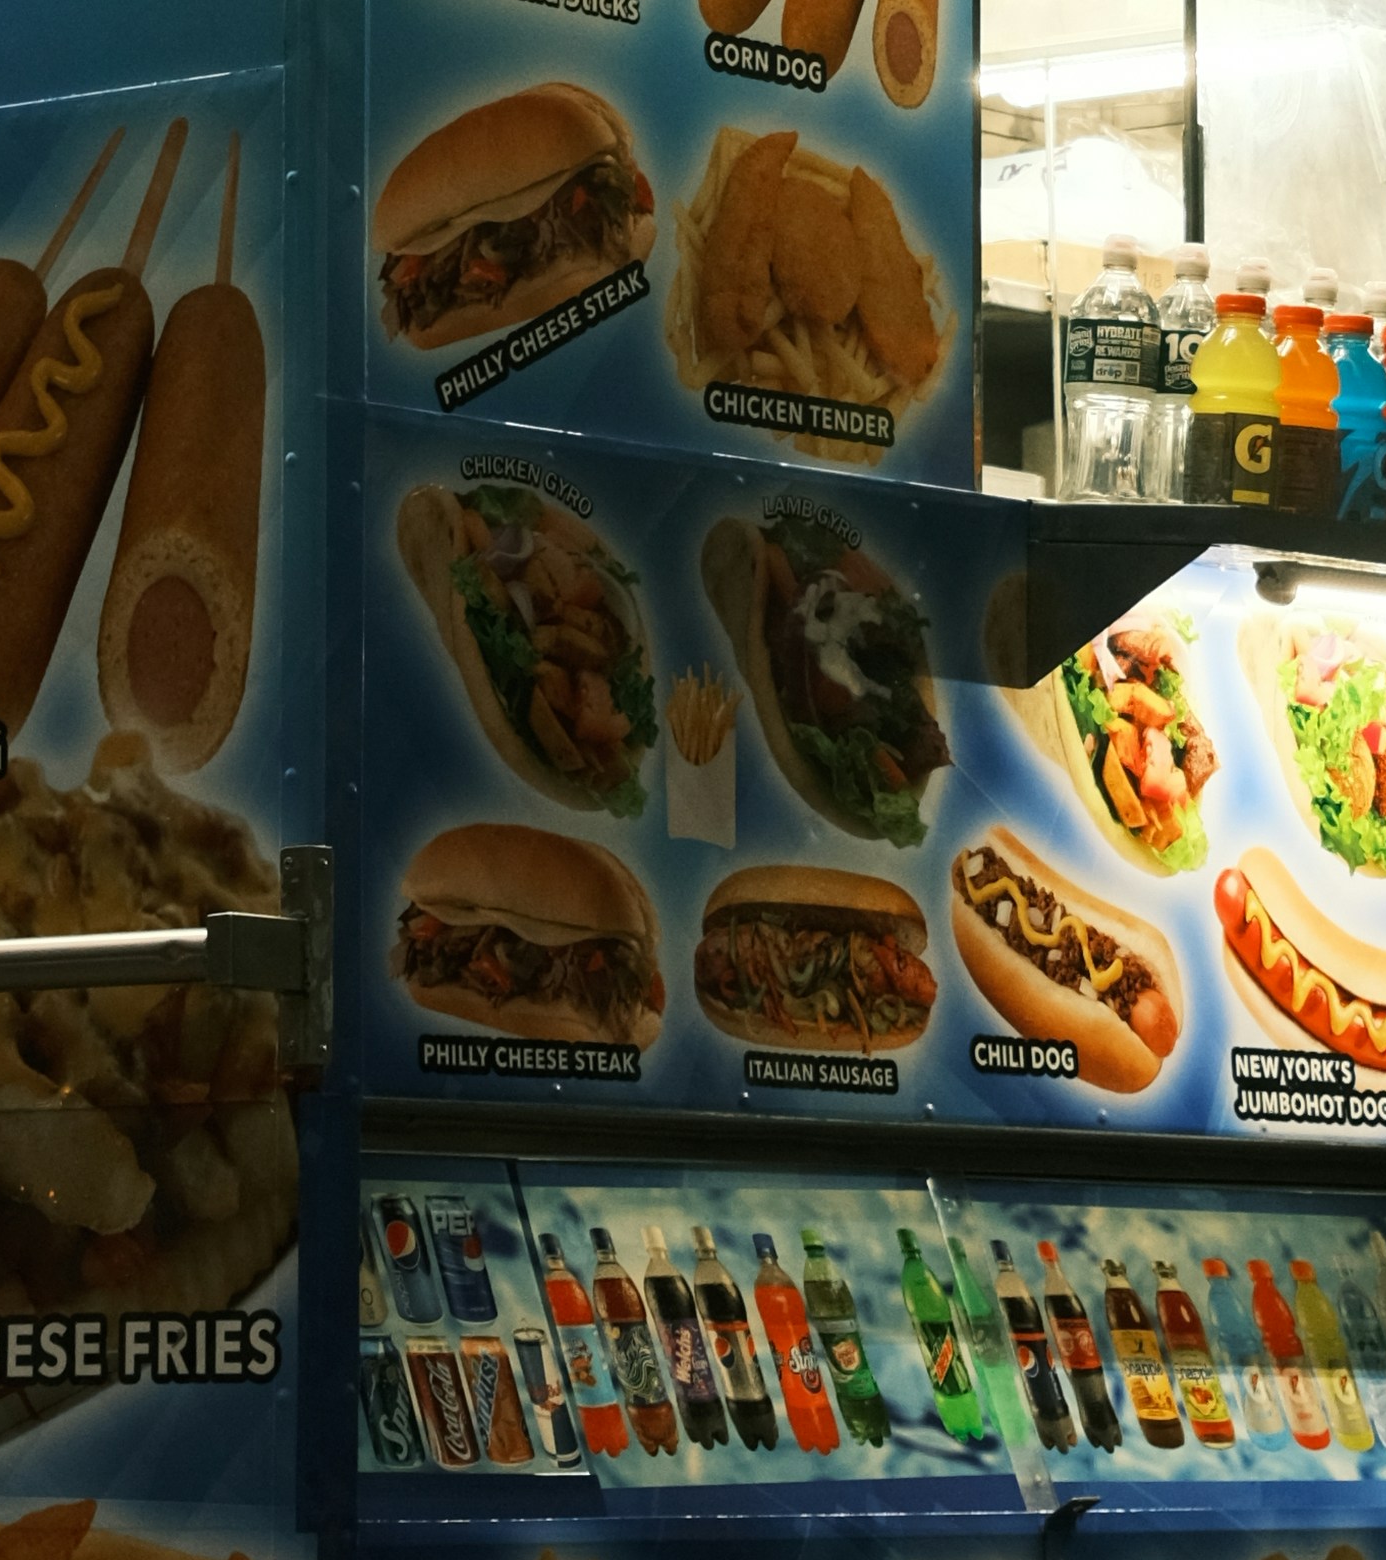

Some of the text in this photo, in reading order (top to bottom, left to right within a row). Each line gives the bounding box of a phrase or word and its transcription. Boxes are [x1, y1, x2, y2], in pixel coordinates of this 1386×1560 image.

[709, 39, 823, 84] CORN DOG
[440, 273, 645, 406] PHILLY CHEESE STEAK
[1097, 325, 1142, 341] HYDRATE
[709, 389, 890, 439] CHICKEN TENDER
[1234, 424, 1272, 474] G
[461, 456, 592, 518] CHICKEN GYRO
[764, 496, 862, 548] LAMB GYRO
[424, 1043, 635, 1075] PHILLY CHEESE STEAK
[749, 1059, 894, 1087] ITALIAN SAUSAGE
[974, 1042, 1075, 1072] CHILI DOG
[1235, 1054, 1352, 1084] NEW YORK'S
[124, 1314, 278, 1376] FRIES
[675, 1326, 695, 1385] Welch's
